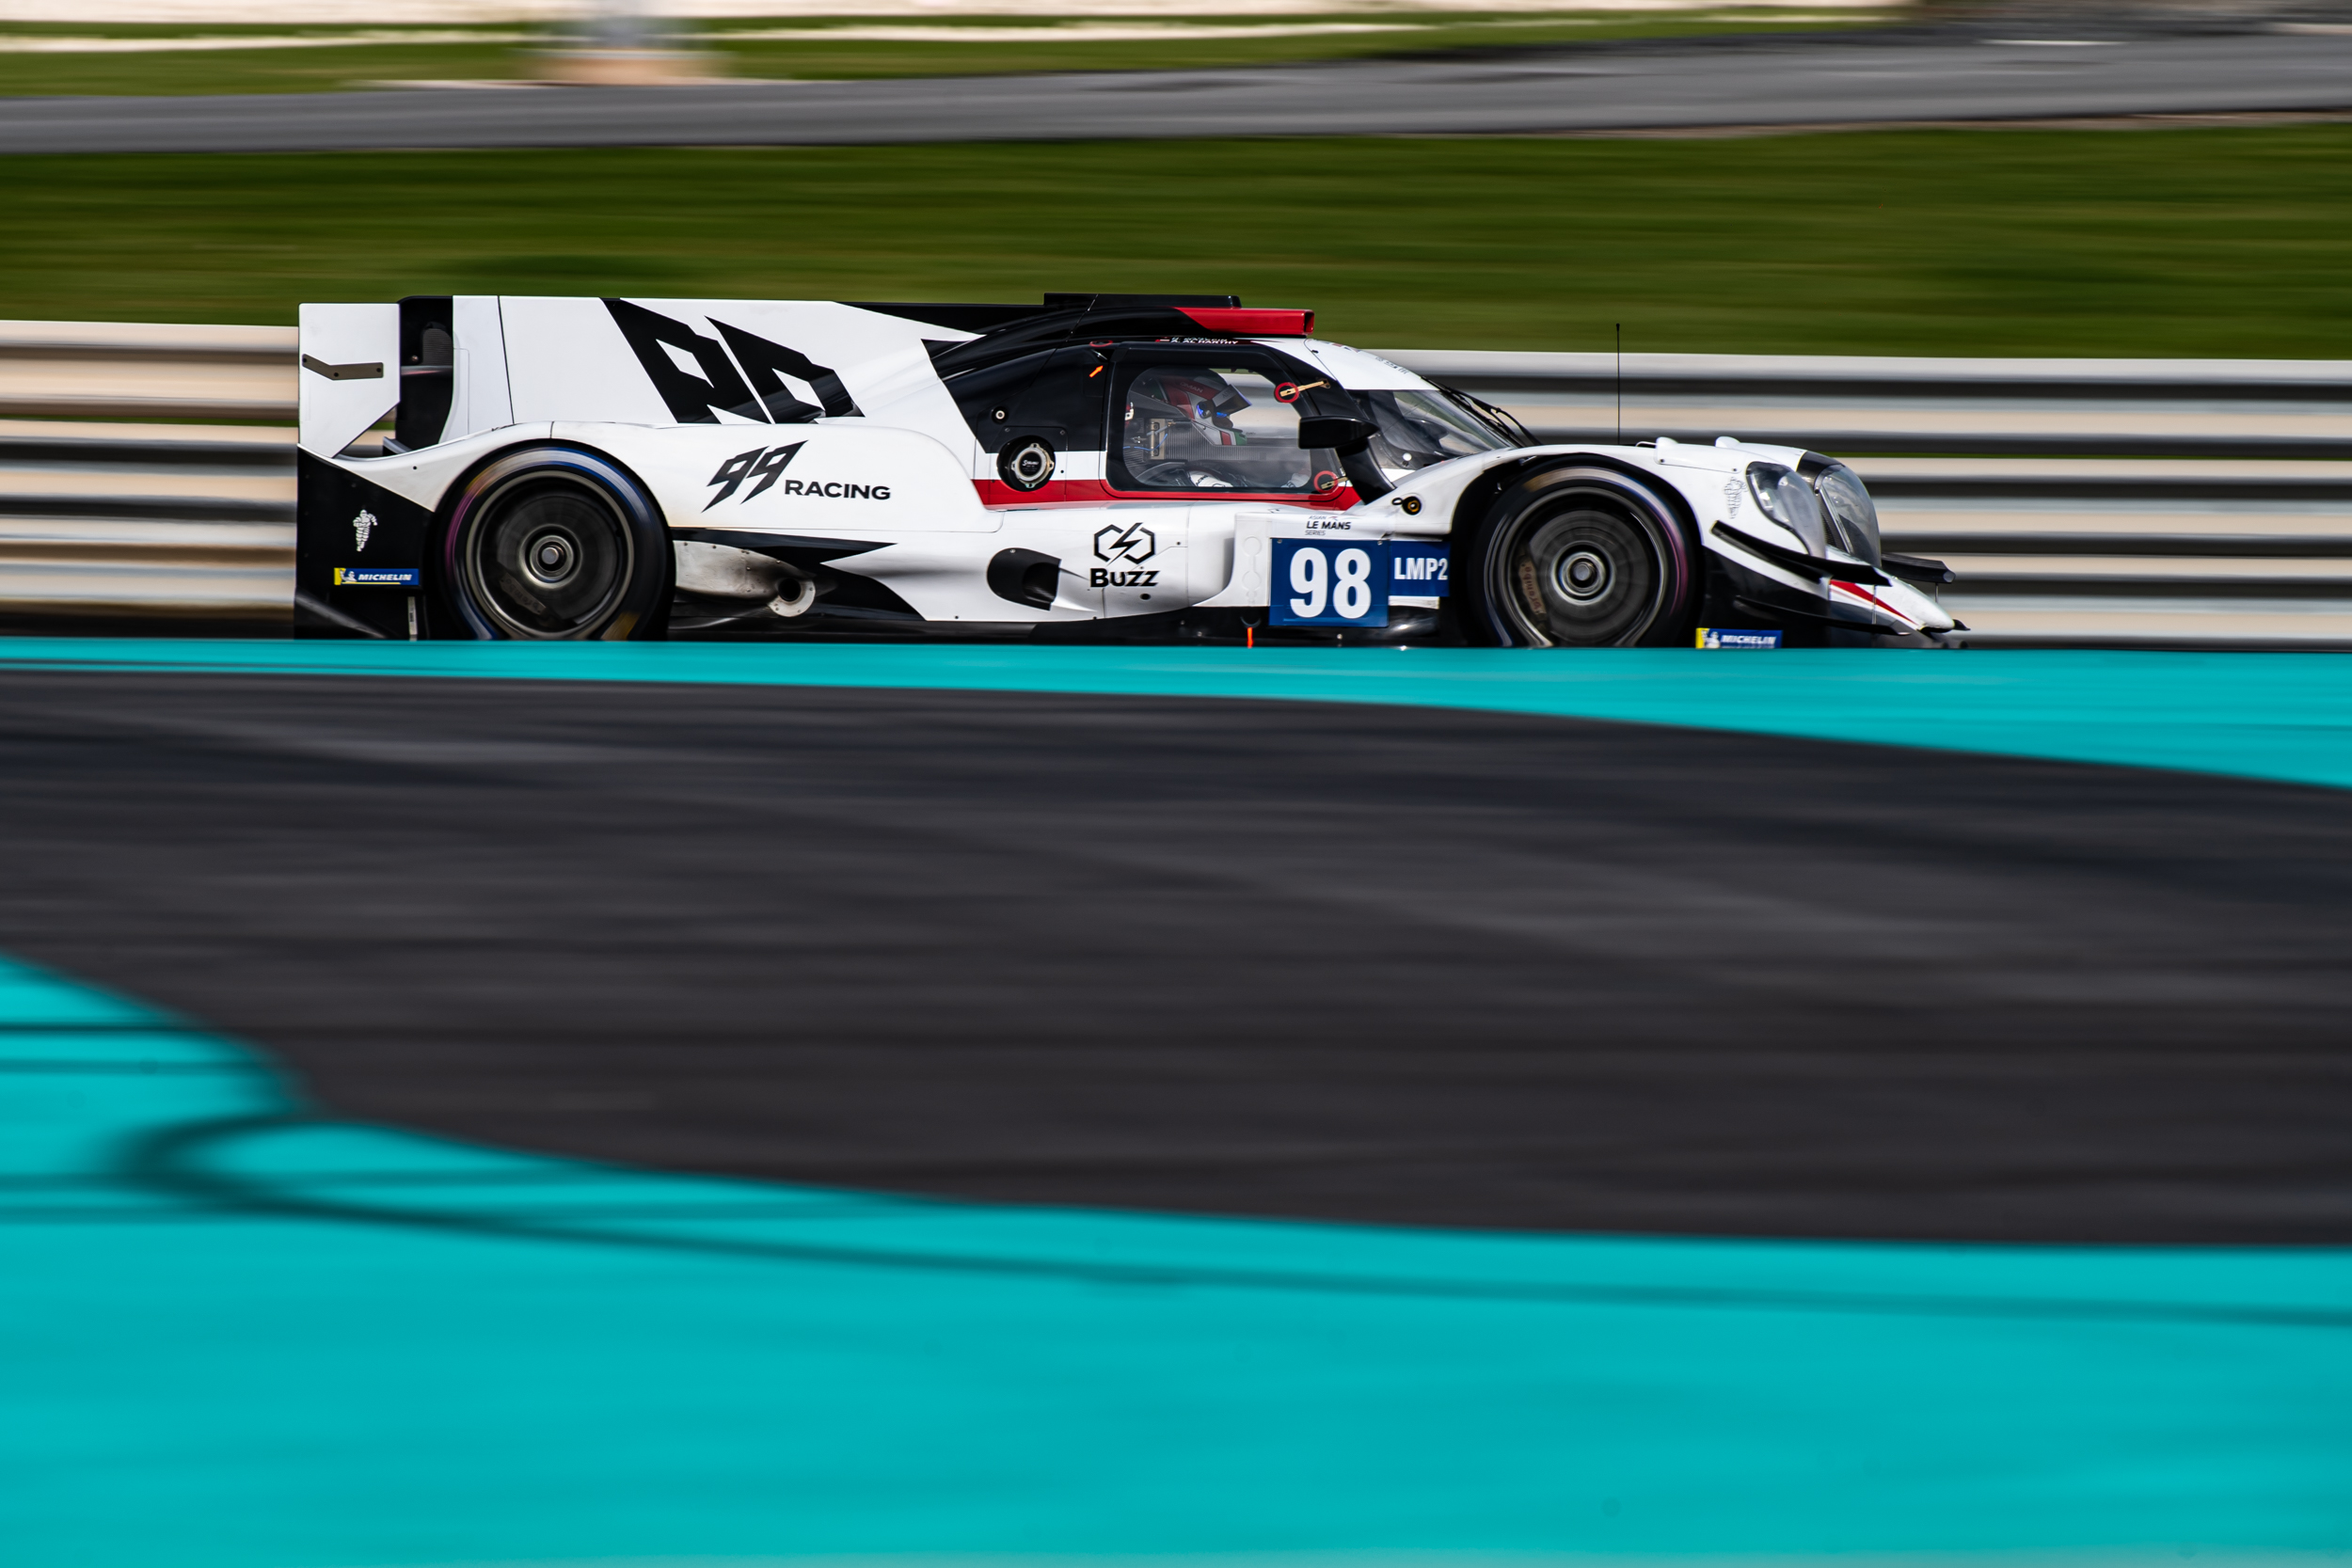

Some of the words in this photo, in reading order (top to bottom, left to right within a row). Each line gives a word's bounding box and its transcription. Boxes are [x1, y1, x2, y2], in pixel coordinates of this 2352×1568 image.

[701, 439, 809, 514] 99
[785, 480, 891, 500] RACING
[1306, 520, 1319, 530] LE
[1321, 521, 1352, 531] MANS
[1393, 557, 1449, 580] LMP2
[1290, 546, 1372, 619] 98
[1720, 634, 1777, 645] MICHELIN
